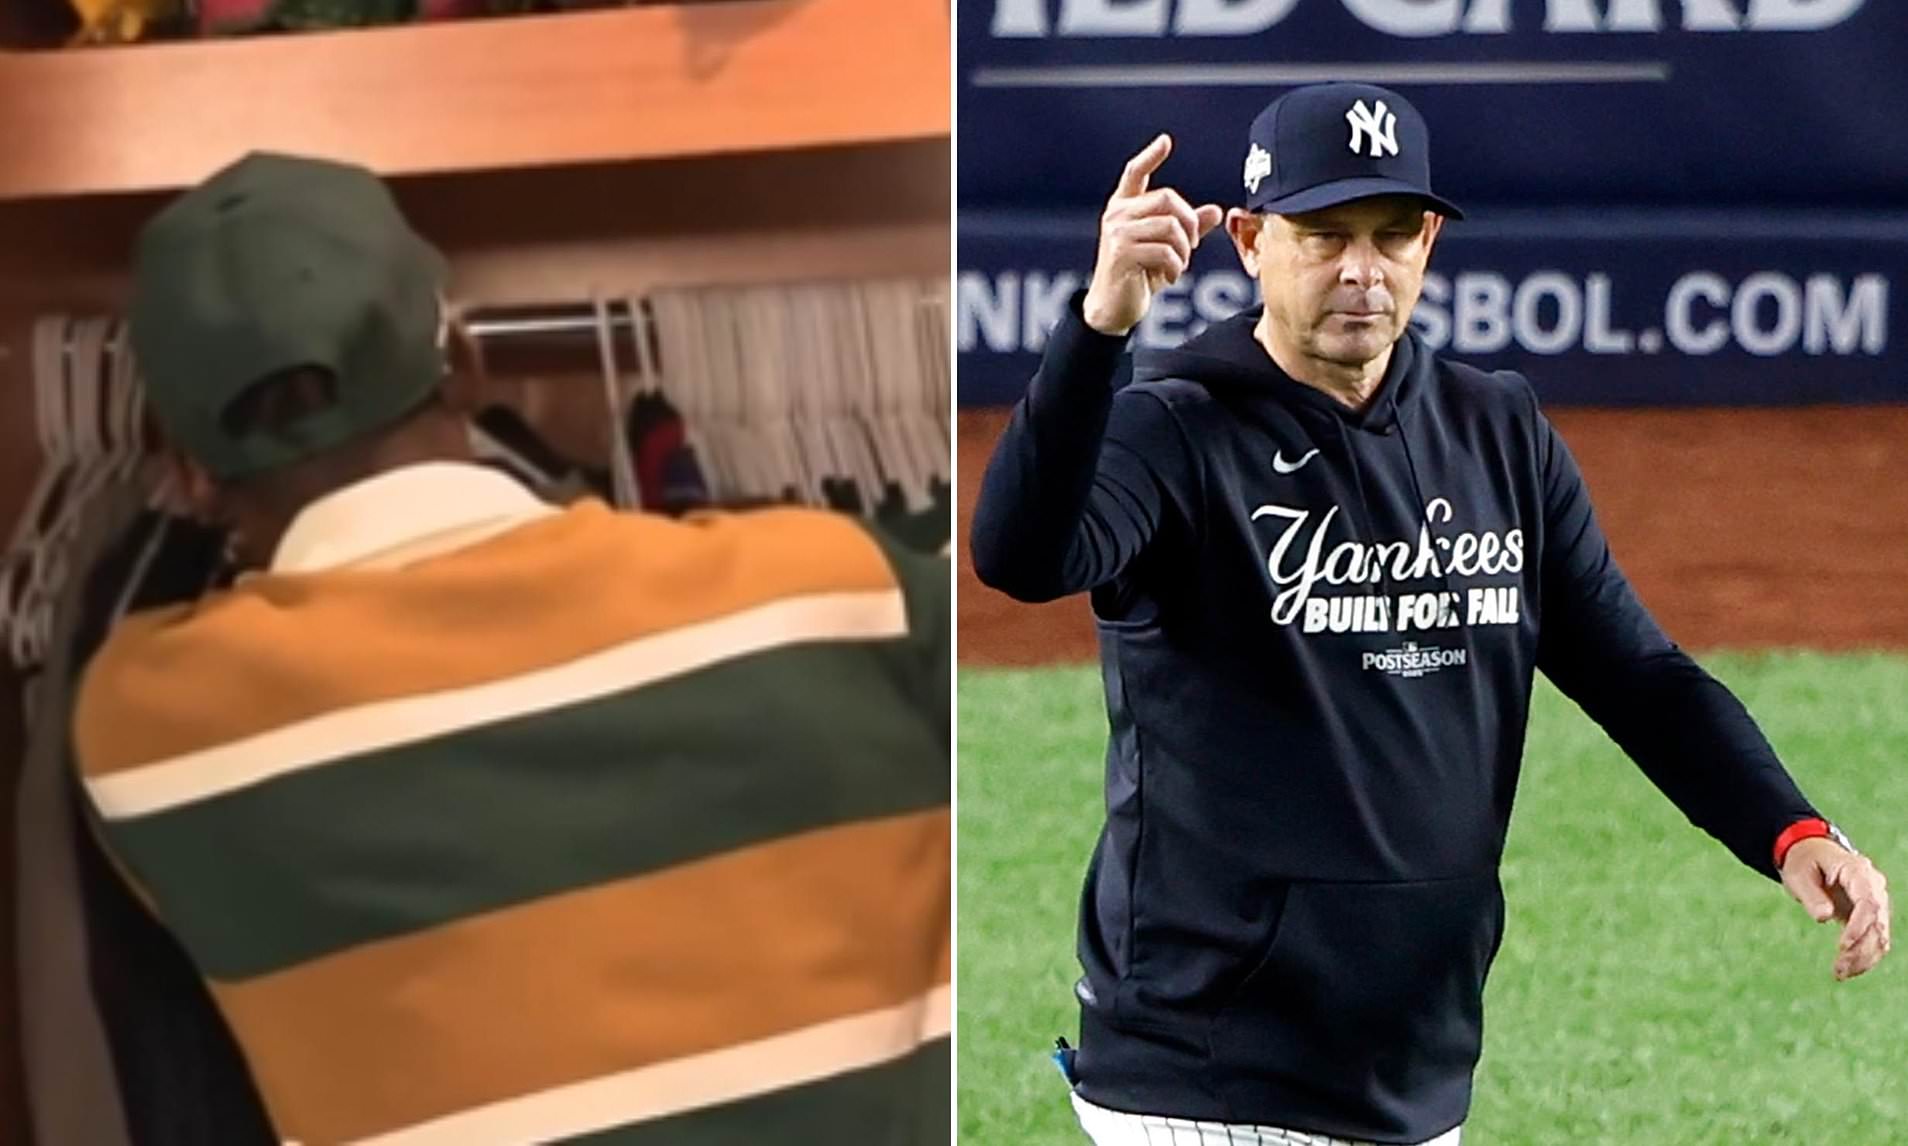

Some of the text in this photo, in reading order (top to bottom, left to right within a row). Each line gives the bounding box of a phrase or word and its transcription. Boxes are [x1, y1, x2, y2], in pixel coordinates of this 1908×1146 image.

[1346, 99, 1399, 157] NY
[1251, 498, 1523, 625] Yankees
[1467, 587, 1519, 625] FALL
[1362, 648, 1466, 671] POSTSEASON
